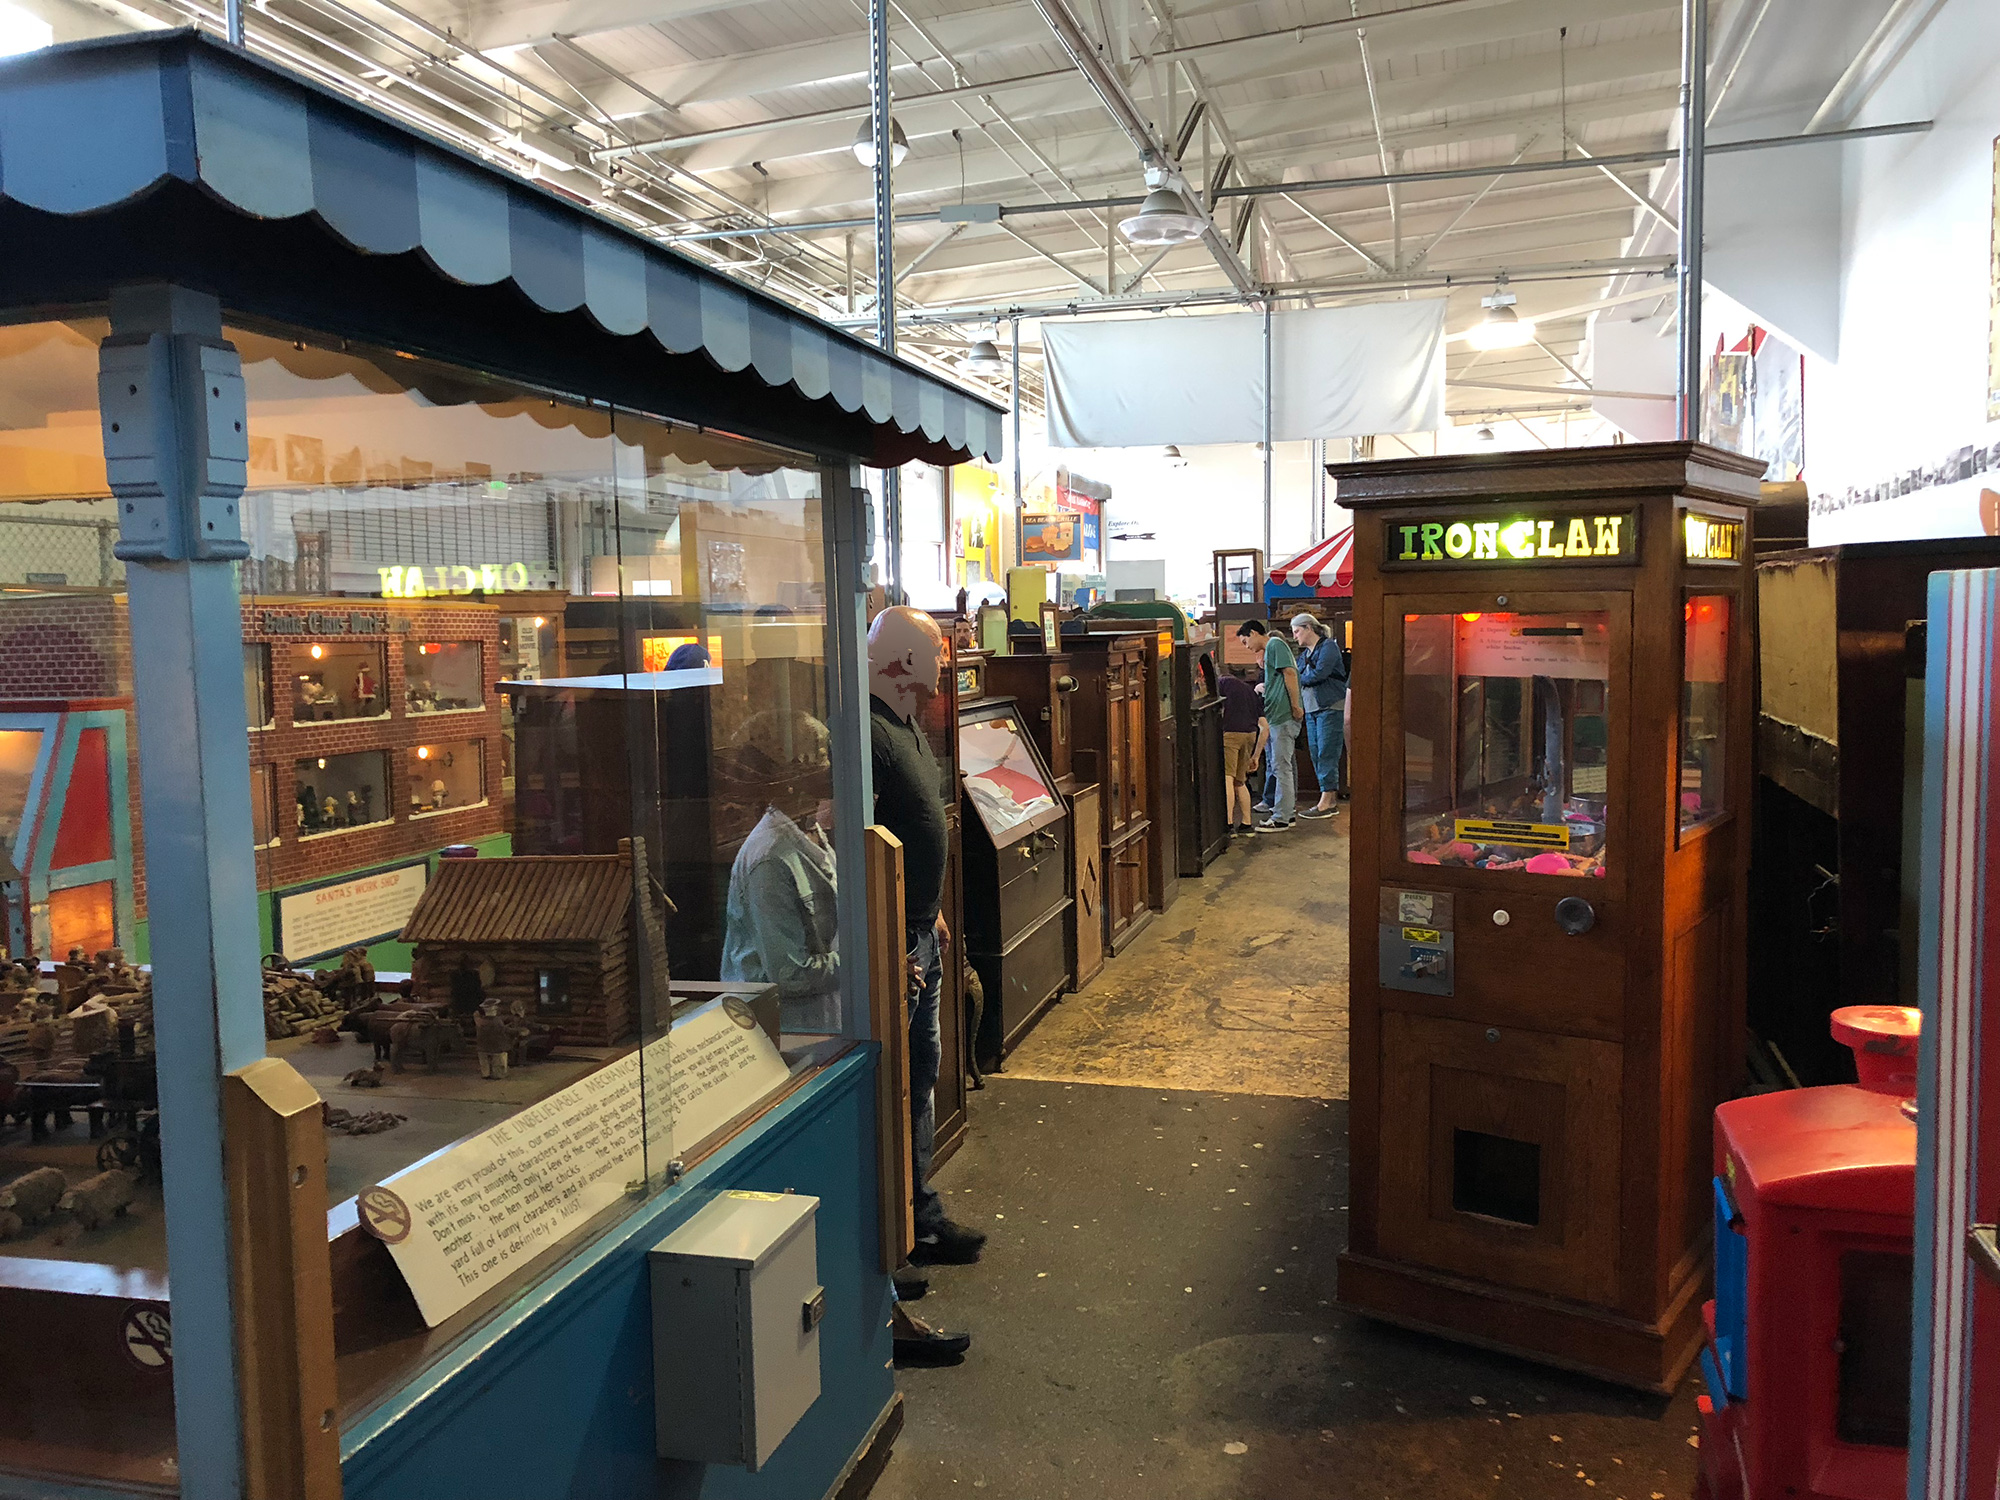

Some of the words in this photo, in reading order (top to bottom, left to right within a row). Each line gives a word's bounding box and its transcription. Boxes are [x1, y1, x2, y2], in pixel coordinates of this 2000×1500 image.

[1399, 521, 1500, 561] IRON
[1500, 517, 1622, 558] CLAW
[414, 1197, 434, 1213] We
[434, 1188, 451, 1203] are
[452, 1176, 472, 1194] very
[471, 1160, 497, 1183] proud
[495, 1153, 506, 1165] of
[528, 1135, 543, 1148] our
[542, 1123, 560, 1139] most
[561, 1102, 598, 1128] remarkable
[599, 1084, 629, 1106] animated
[487, 1126, 512, 1147] THE
[512, 1088, 582, 1134] UNBELIEVABLE
[585, 1056, 647, 1093] MECHANICAL
[647, 1039, 677, 1060] FARM
[425, 1209, 445, 1228] with
[460, 1190, 482, 1208] many
[482, 1168, 517, 1195] amusing
[517, 1144, 557, 1173] characters
[557, 1134, 572, 1149] and
[571, 1119, 599, 1140] animals
[598, 1106, 620, 1127] going
[618, 1095, 637, 1112] about
[432, 1220, 456, 1242] Don't
[478, 1201, 490, 1214] to
[489, 1181, 523, 1207] mention
[522, 1170, 542, 1188] only
[541, 1167, 547, 1175] a
[545, 1157, 562, 1172] few
[562, 1150, 572, 1162] of
[571, 1143, 585, 1156] the
[585, 1135, 600, 1149] over
[599, 1125, 613, 1139] 150
[613, 1112, 638, 1133] moving
[441, 1230, 473, 1256] mother
[488, 1210, 504, 1226] the
[504, 1200, 521, 1215] hen
[523, 1188, 539, 1204] and
[538, 1179, 554, 1194] her
[554, 1163, 580, 1184] chicks
[595, 1145, 610, 1158] the
[609, 1135, 626, 1149] two
[628, 1114, 661, 1139] charcters
[449, 1250, 470, 1273] yard
[469, 1240, 485, 1257] full
[485, 1233, 496, 1248] of
[496, 1219, 521, 1242] funny
[521, 1193, 561, 1224] characters
[560, 1182, 577, 1199] and
[576, 1175, 587, 1188] all
[587, 1160, 612, 1181] around
[611, 1153, 624, 1165] the
[622, 1141, 640, 1157] farm
[457, 1267, 479, 1287] This
[480, 1255, 498, 1273] one
[498, 1247, 508, 1260] is
[508, 1220, 551, 1255] definitely
[550, 1216, 557, 1226] a
